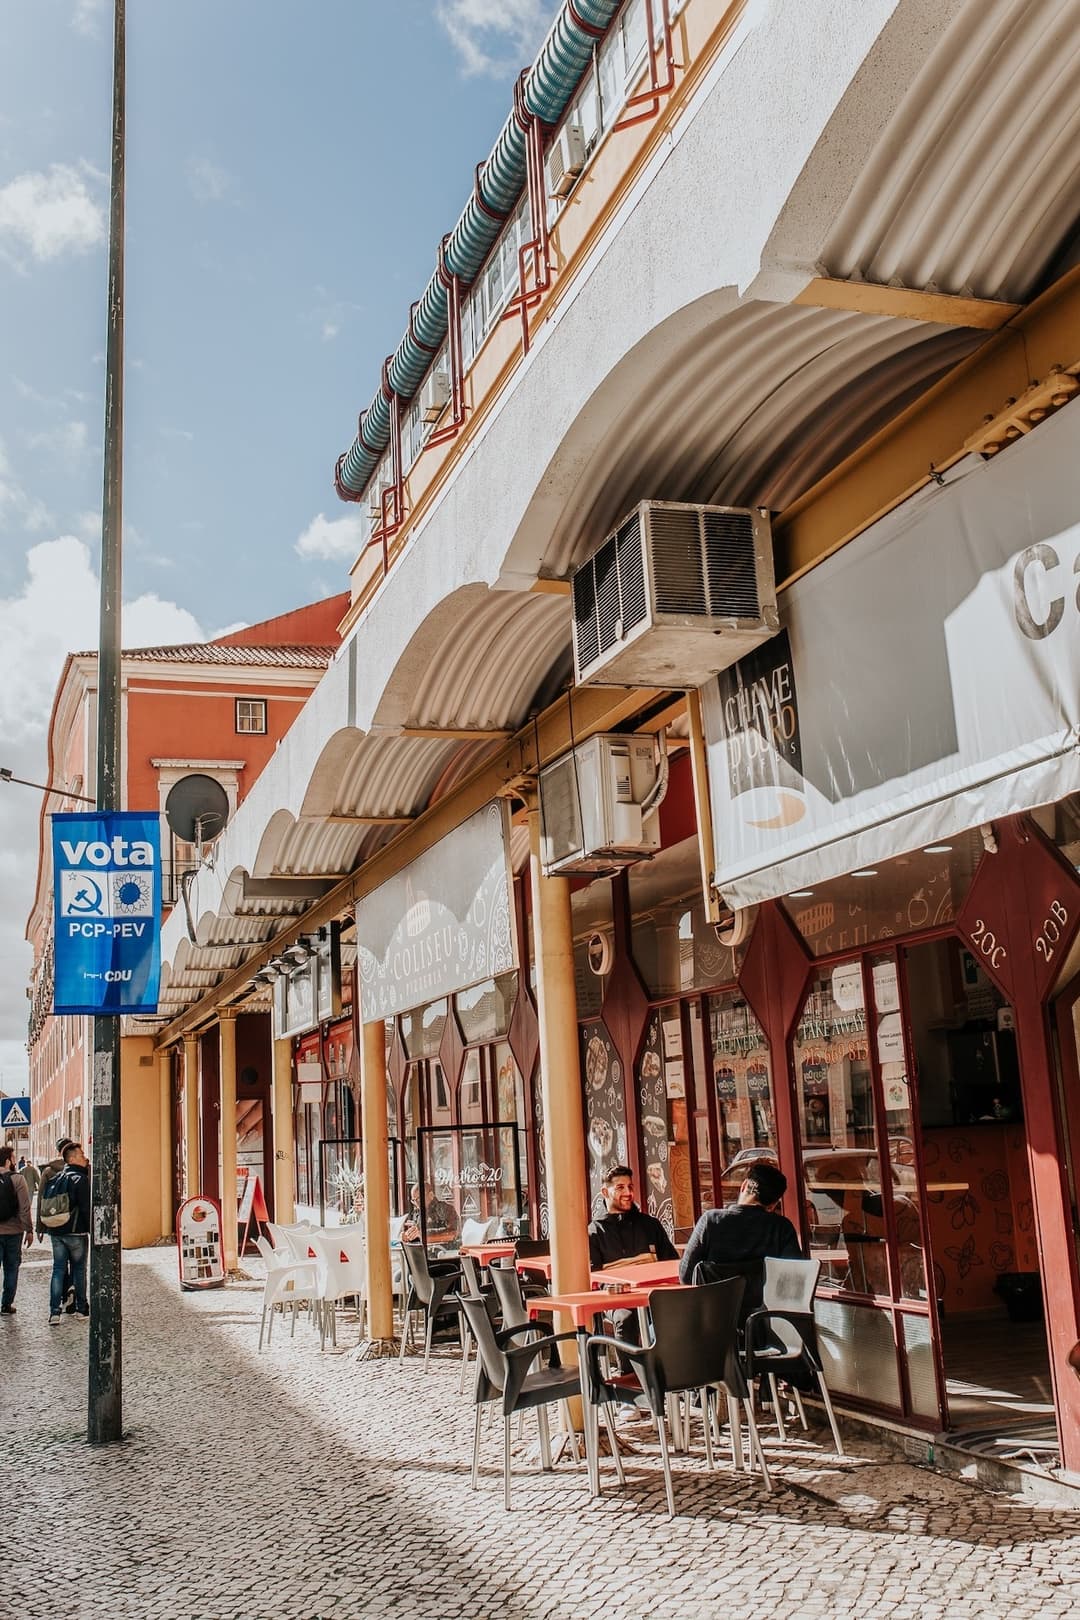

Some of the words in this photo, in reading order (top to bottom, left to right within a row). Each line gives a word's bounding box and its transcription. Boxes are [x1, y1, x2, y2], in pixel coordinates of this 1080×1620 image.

[1014, 543, 1080, 641] C
[725, 663, 793, 733] CHAVE
[60, 835, 154, 866] vota
[69, 922, 146, 938] PCP-PEV
[969, 919, 1007, 969] 20C
[1035, 899, 1068, 962] 20B
[393, 924, 453, 981] COLISEU
[104, 969, 132, 982] CDU
[716, 1033, 761, 1055] DELIVERY
[801, 1020, 831, 1041] TAKE
[832, 1014, 865, 1036] AWAY
